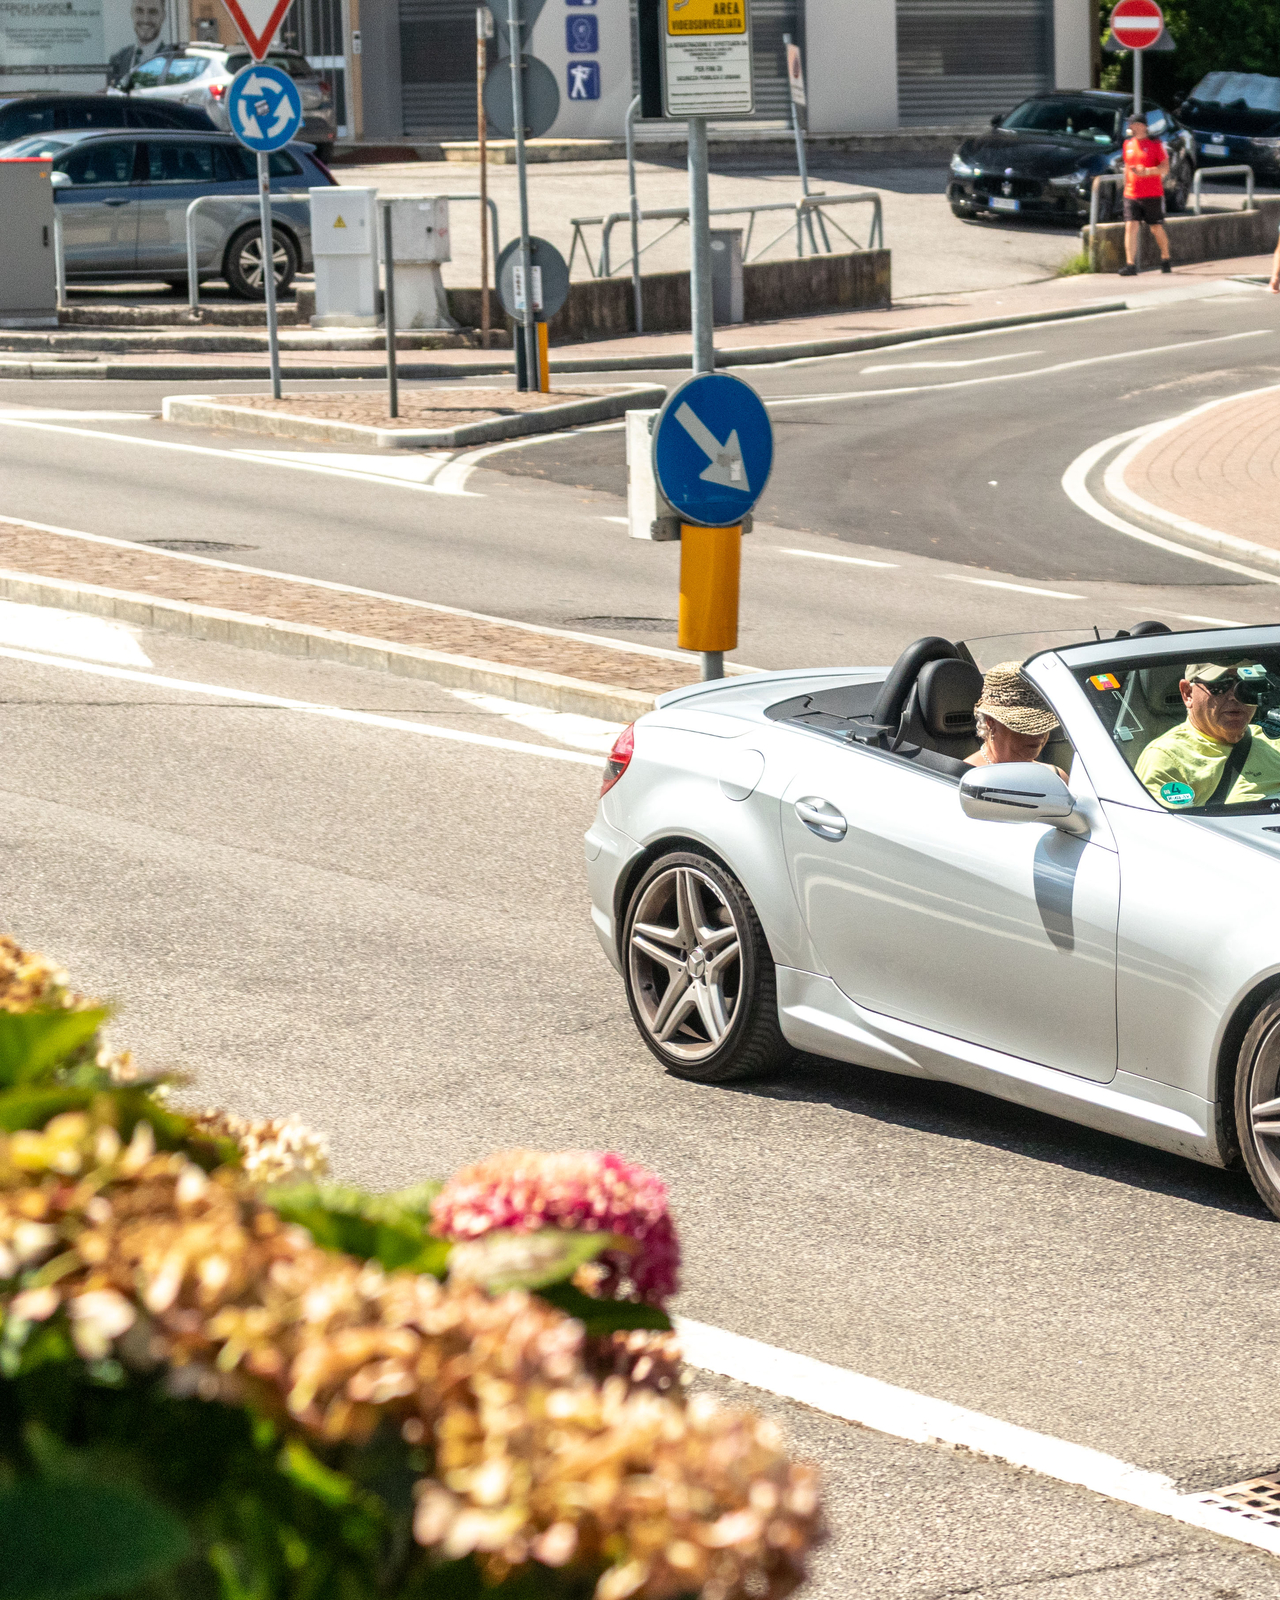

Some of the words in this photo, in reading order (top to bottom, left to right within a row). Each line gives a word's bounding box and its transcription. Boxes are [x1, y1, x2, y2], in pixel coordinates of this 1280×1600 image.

[713, 2, 740, 15] AREA
[672, 19, 741, 30] VIDEOSORVEGLIATA
[1171, 783, 1181, 794] 4
